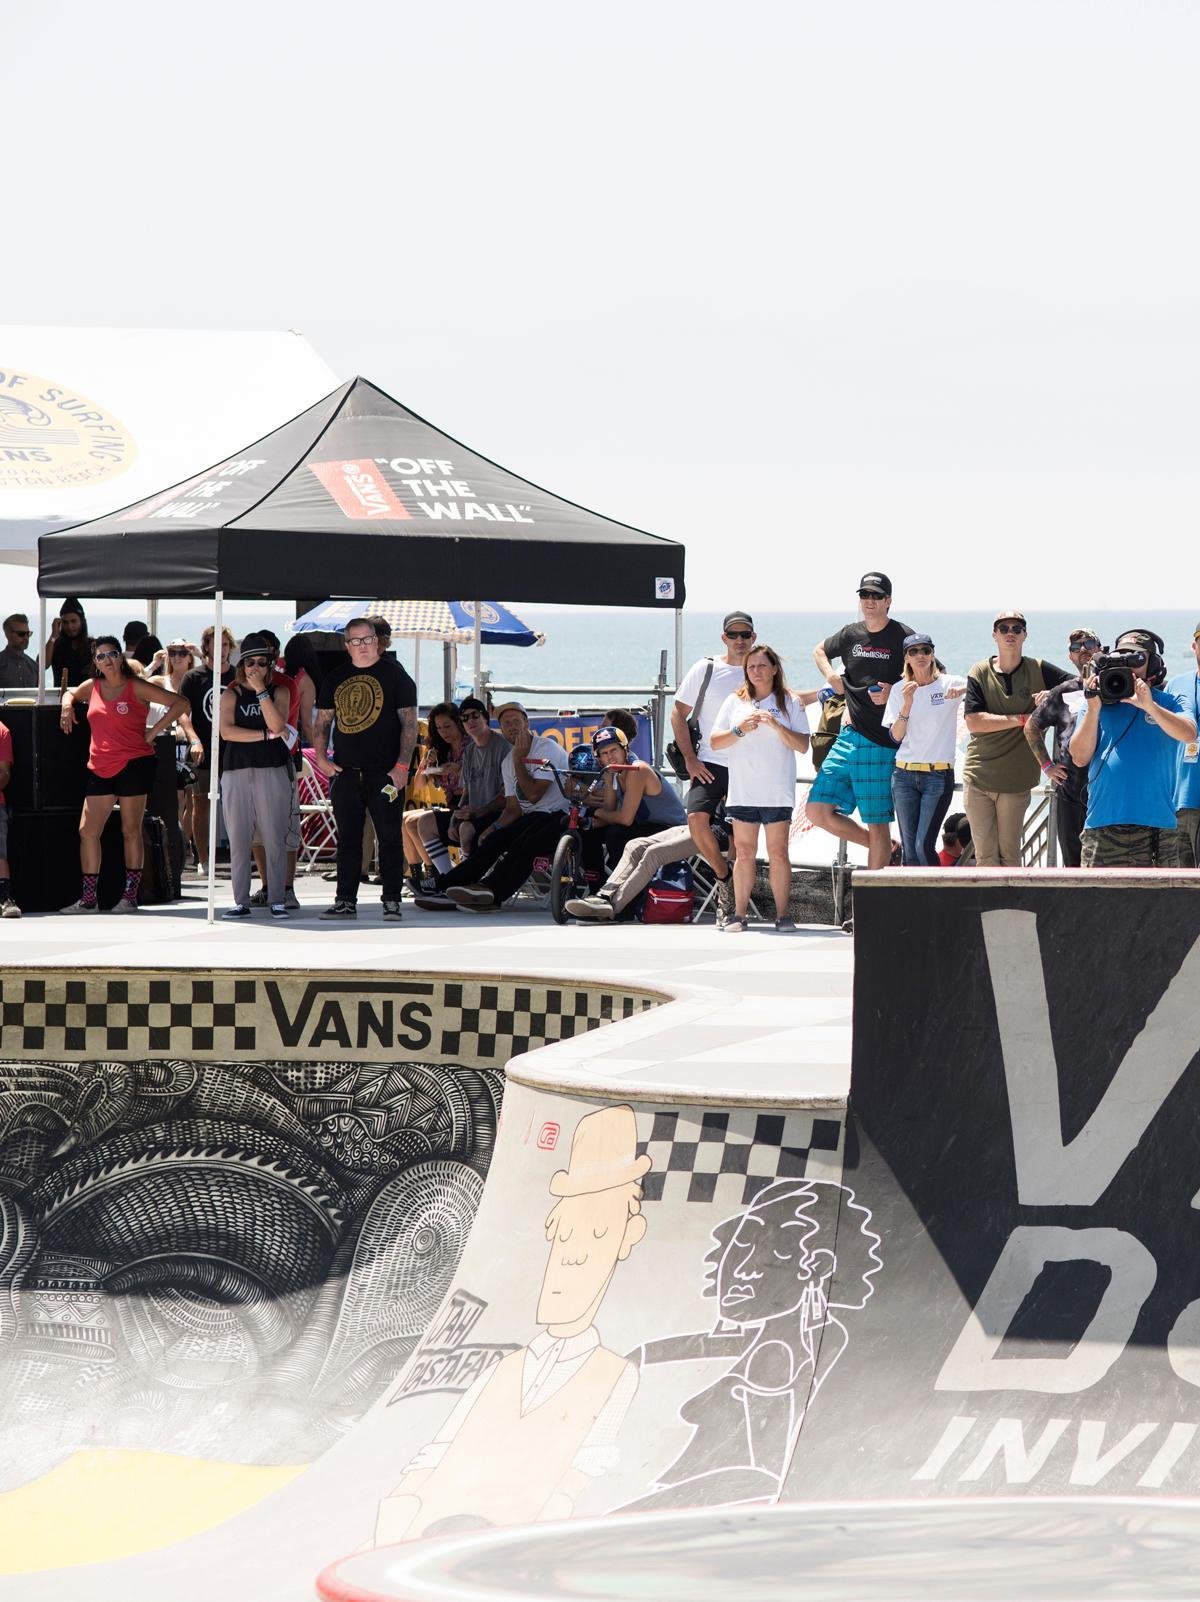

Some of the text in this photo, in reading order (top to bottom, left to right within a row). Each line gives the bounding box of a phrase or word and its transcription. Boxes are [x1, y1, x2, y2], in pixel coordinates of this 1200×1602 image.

[39, 388, 125, 462] SURFING
[0, 446, 52, 462] NS
[402, 479, 476, 498] THE
[417, 501, 535, 524] WALL"
[240, 703, 261, 716] VA
[265, 980, 434, 1049] VANS
